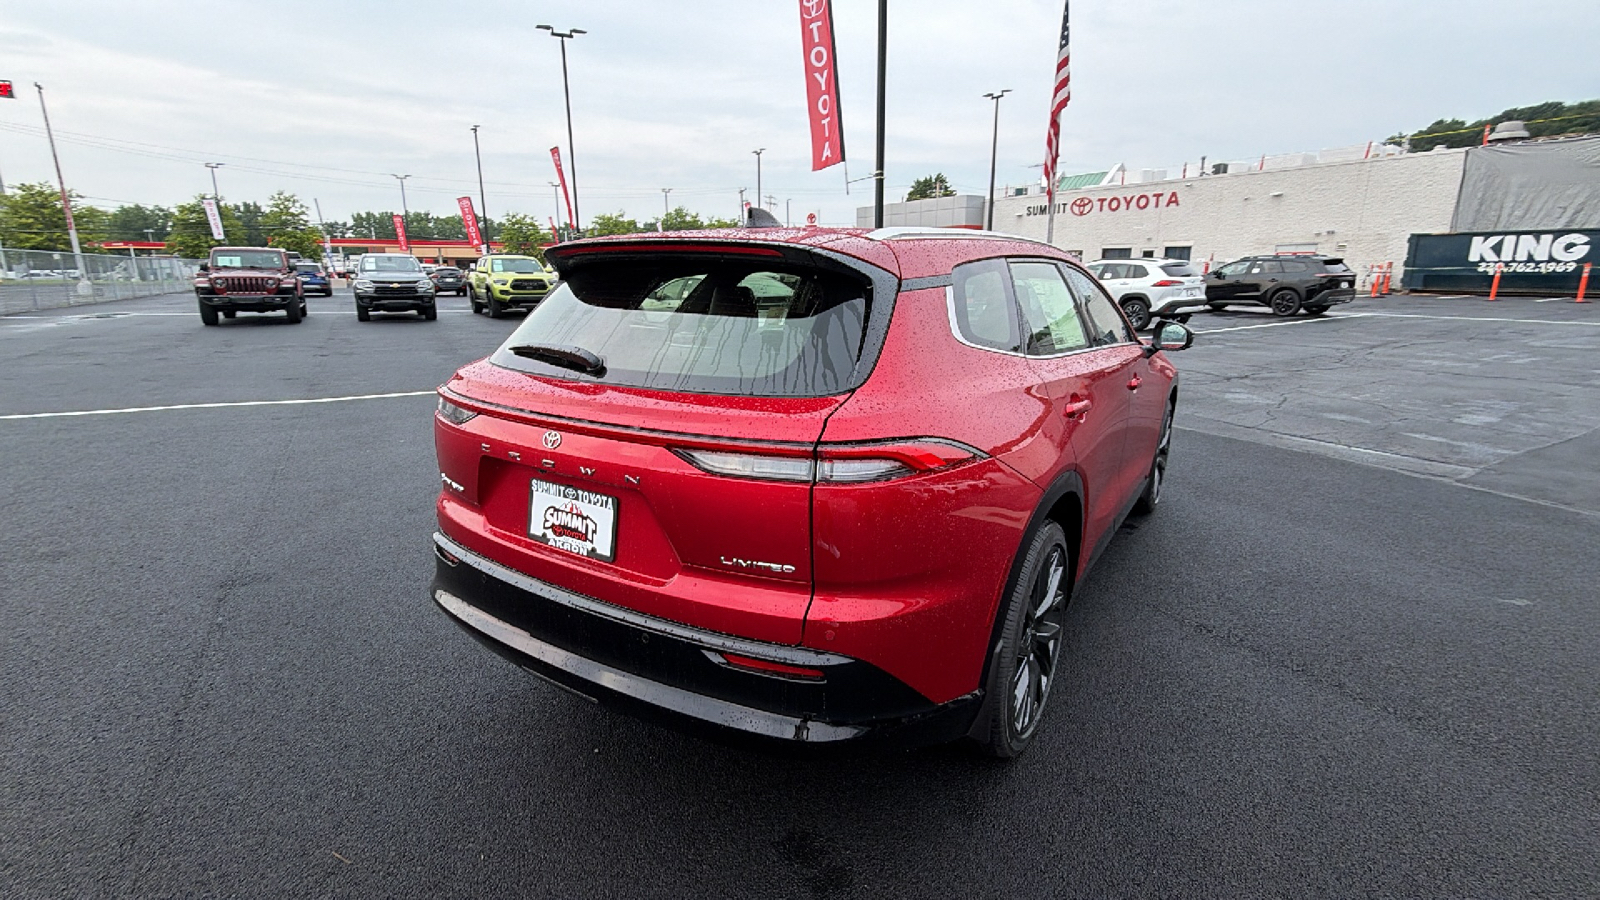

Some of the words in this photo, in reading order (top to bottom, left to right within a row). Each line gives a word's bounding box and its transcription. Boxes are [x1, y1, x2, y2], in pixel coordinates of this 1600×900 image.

[809, 21, 832, 161] TOYOTA
[1096, 191, 1180, 212] TOYOTA
[463, 207, 479, 246] TOYOTA
[1467, 233, 1591, 262] KING
[531, 479, 565, 499] SUMMIT
[577, 489, 613, 510] TOYOTA
[544, 506, 597, 541] SUMMIT
[563, 529, 587, 541] TOYOTA
[548, 538, 588, 556] AKRON
[720, 556, 796, 573] LIMITED
